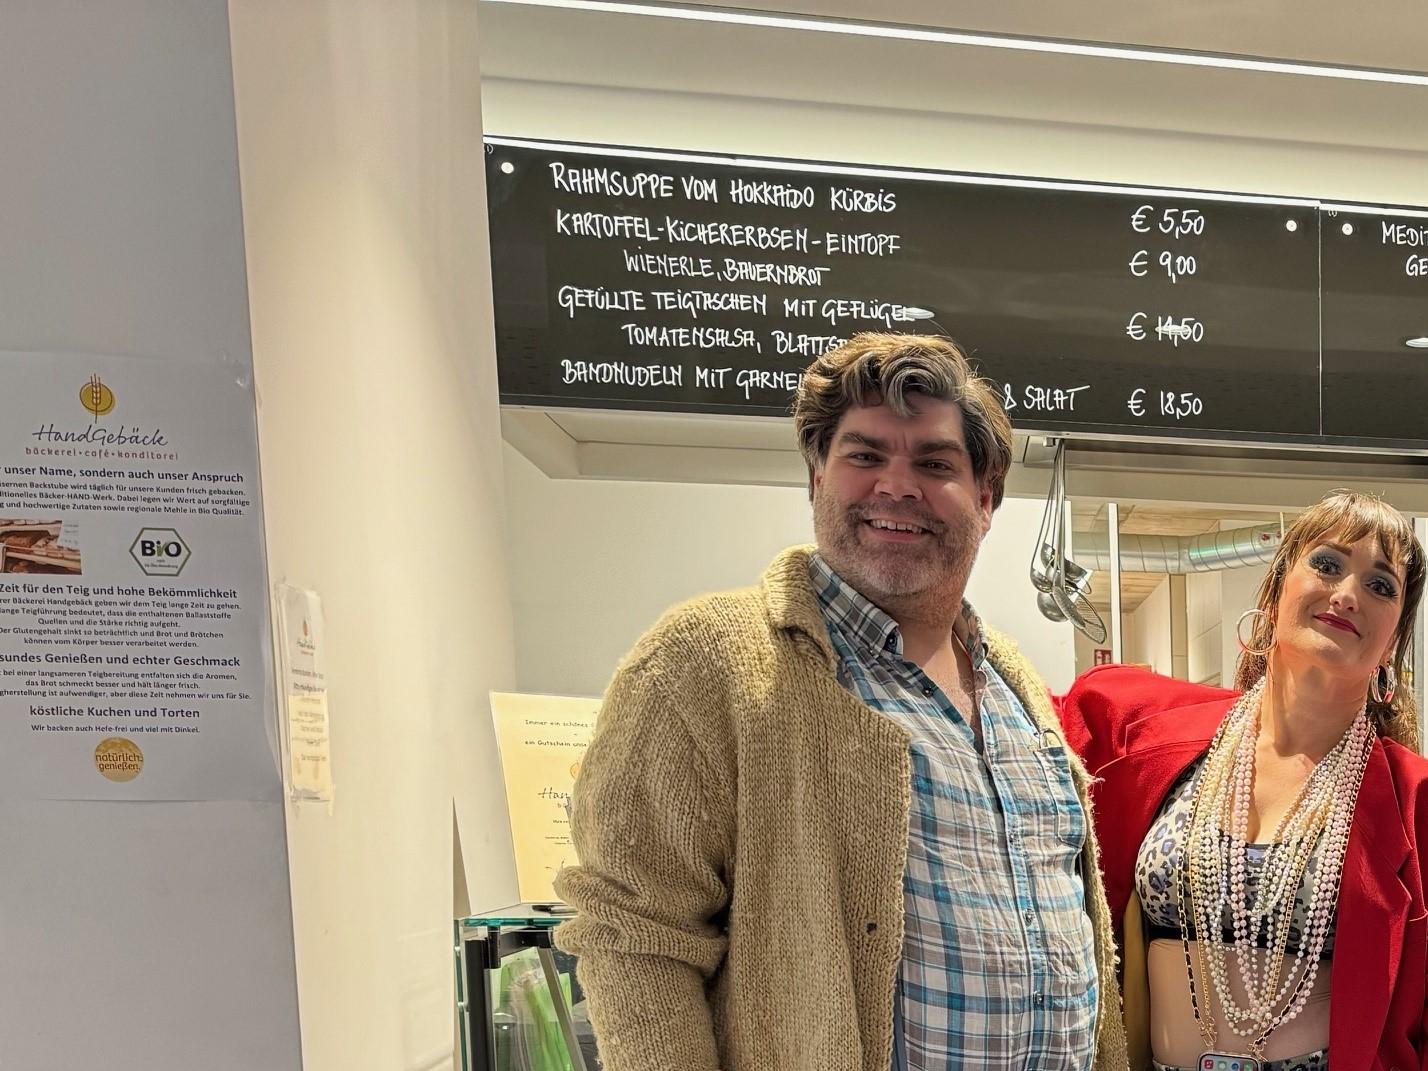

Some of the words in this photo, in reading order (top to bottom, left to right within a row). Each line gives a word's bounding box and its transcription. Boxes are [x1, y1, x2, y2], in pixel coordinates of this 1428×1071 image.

[549, 162, 674, 199] RAHMSUPPE
[681, 175, 719, 204] VOM
[729, 179, 815, 208] HOKKAIDO
[830, 187, 897, 213] KÜRBIS
[1131, 205, 1153, 233] €
[1158, 208, 1205, 239] 5,50
[624, 245, 722, 282] WIENERLE,
[723, 257, 830, 286] BAUERNBROT
[1129, 250, 1148, 276] €
[1159, 251, 1196, 284] 9,00
[558, 285, 646, 318] GEFÜLLTE
[651, 289, 767, 319] TEIGTASCHEN
[783, 297, 817, 318] MIT
[822, 298, 915, 329] GEFLÜGEL
[1126, 312, 1148, 340] €
[621, 322, 762, 353] TOMATENSALSA,
[771, 330, 848, 355] BLATTS
[560, 359, 684, 388] BANDNUDELN
[695, 365, 733, 389] MIT
[736, 369, 805, 399] GARNEL
[1023, 384, 1091, 411] SALAT
[1127, 388, 1146, 416] €
[1160, 390, 1203, 420] 18,50
[32, 423, 169, 446] HandGebäck
[4, 466, 36, 476] unser
[39, 466, 77, 478] Name,
[79, 467, 125, 479] sondern
[128, 469, 154, 480] auch
[157, 472, 190, 481] unser
[192, 472, 244, 484] Anspruch
[22, 584, 40, 594] für
[42, 584, 64, 594] den
[66, 585, 90, 597] Teig
[93, 586, 114, 596] und
[117, 586, 145, 597] hohe
[148, 587, 238, 599] Bekömmlichkeit
[0, 652, 41, 663] sundes
[45, 653, 103, 664] Genießen
[106, 654, 129, 664] und
[132, 655, 171, 665] echter
[173, 655, 241, 667] Geschmack
[29, 705, 84, 717] köstliche
[87, 706, 131, 718] Kuchen
[134, 707, 157, 718] und
[160, 708, 200, 719] Torten
